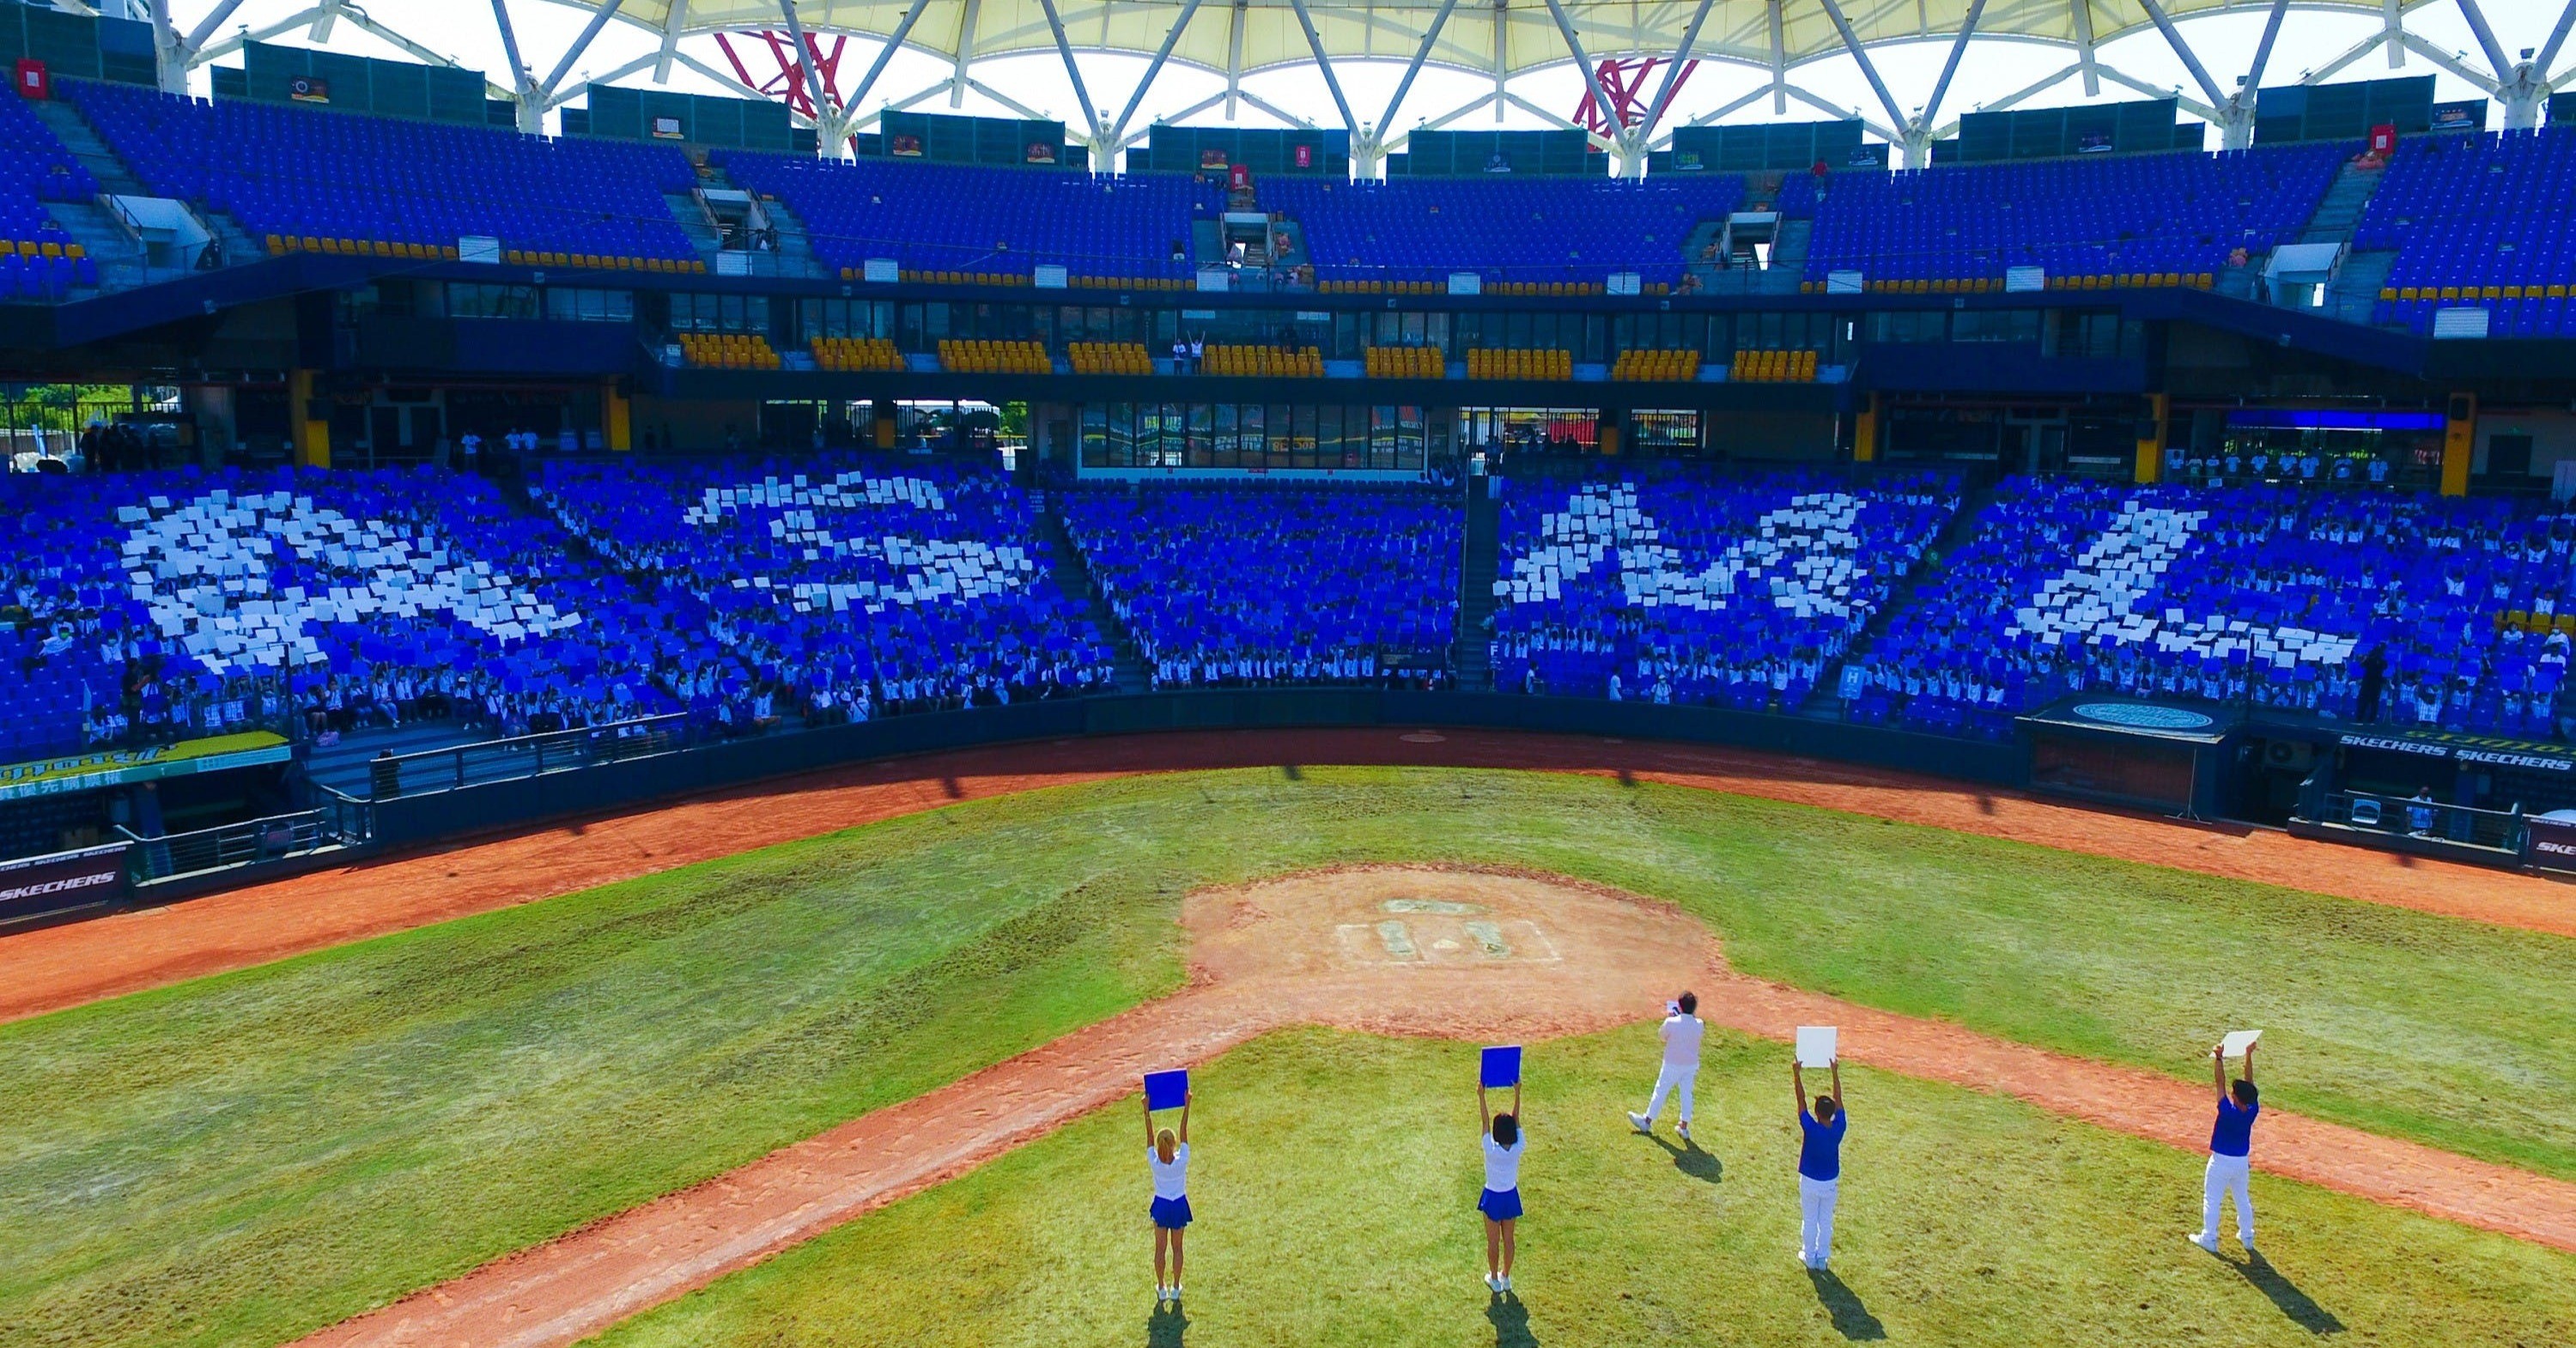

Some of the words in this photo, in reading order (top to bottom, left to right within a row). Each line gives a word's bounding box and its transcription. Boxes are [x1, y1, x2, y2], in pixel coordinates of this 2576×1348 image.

[1847, 671, 1859, 683] H
[2339, 734, 2447, 756] SKECHERS
[2454, 749, 2573, 771] SKECHERS
[0, 871, 116, 902] SKECHERS
